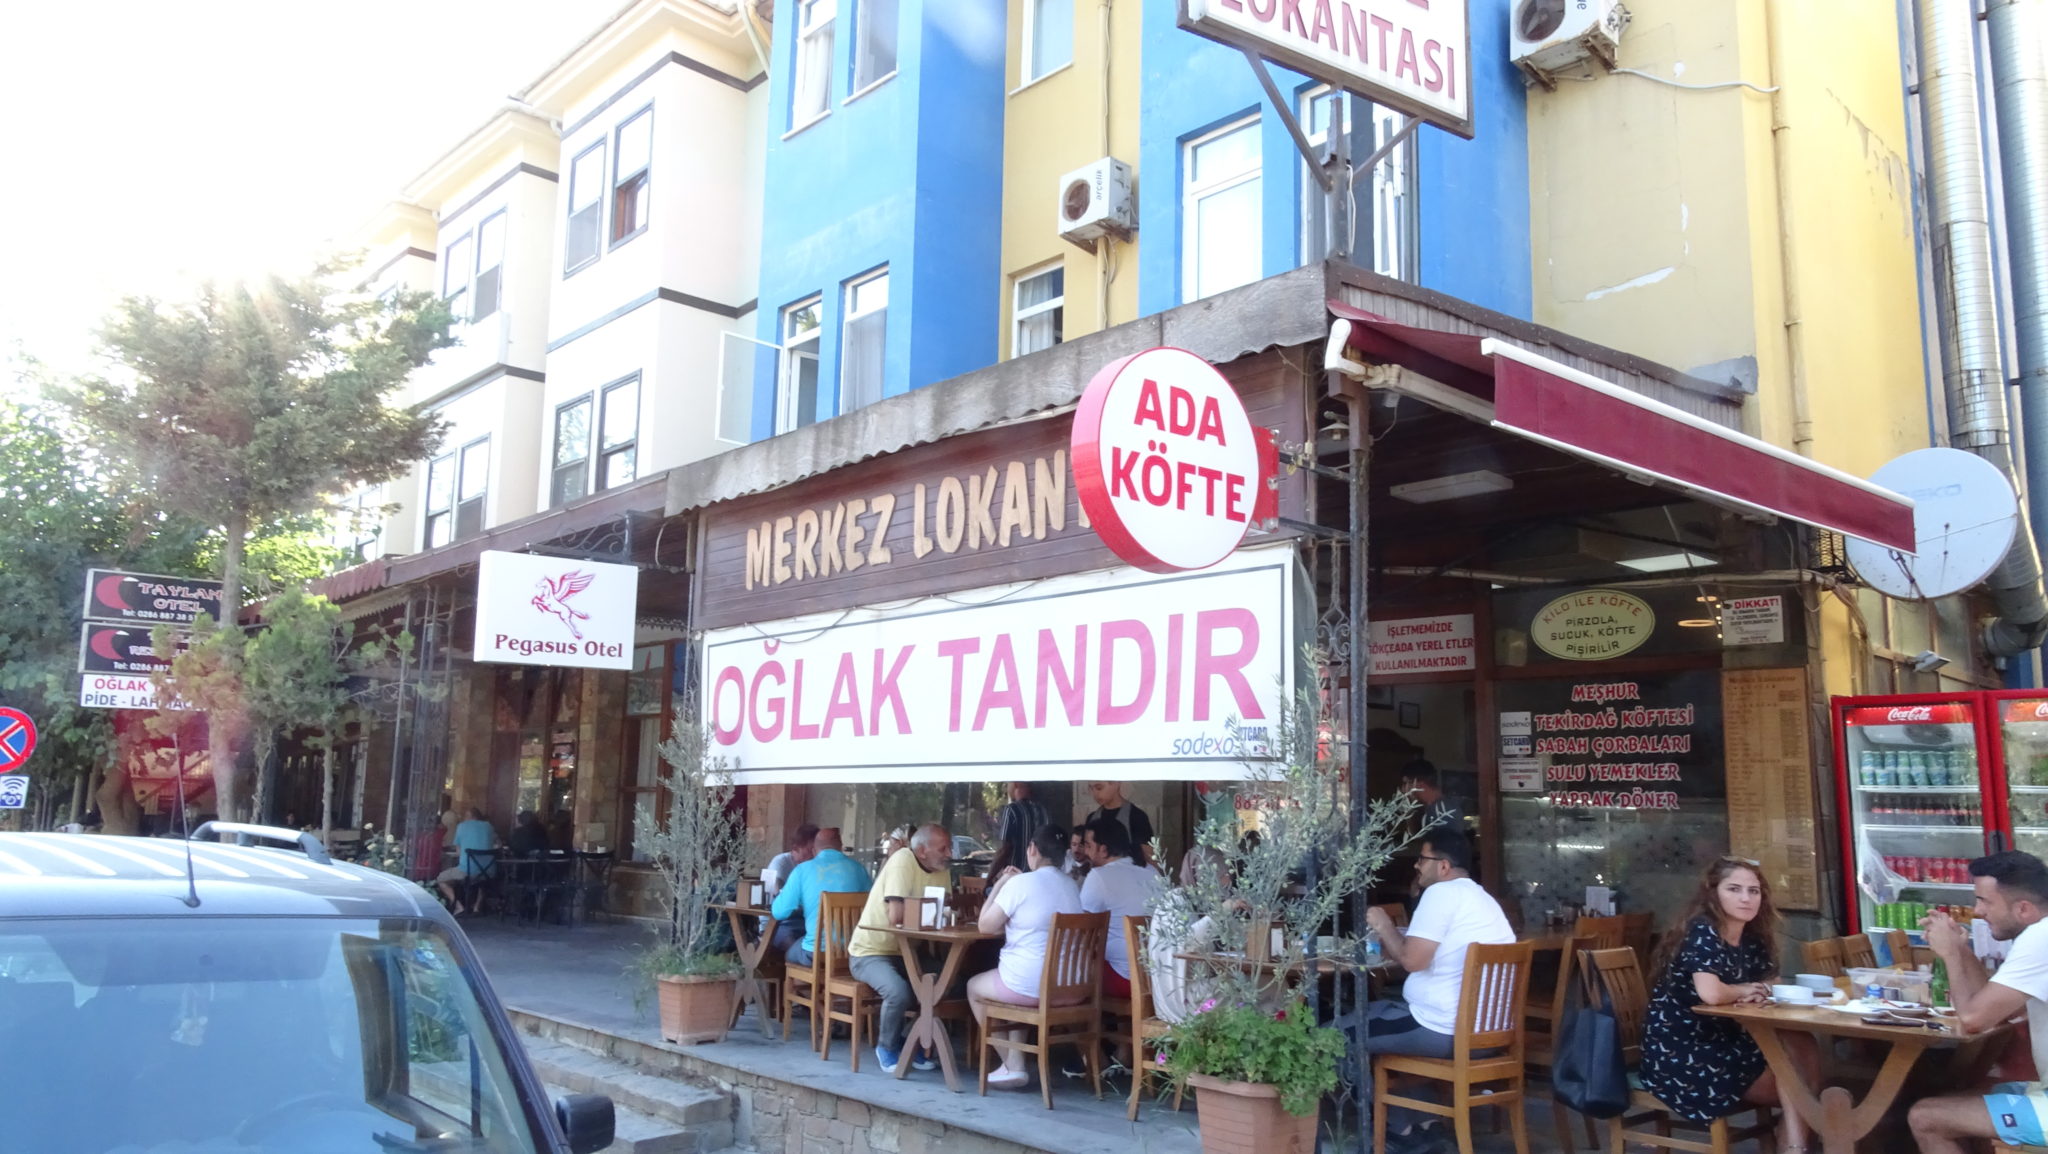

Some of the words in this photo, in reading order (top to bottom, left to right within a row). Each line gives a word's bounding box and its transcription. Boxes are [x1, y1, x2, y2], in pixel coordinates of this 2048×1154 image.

[1221, 0, 1455, 100] OKANTASI
[1134, 378, 1226, 447] ADA
[1111, 440, 1246, 523] KÖFTE
[746, 493, 896, 591] MERKEZ
[914, 449, 1091, 559] LOKAN
[153, 598, 205, 612] OTEL
[1600, 595, 1642, 616] KÖFTE
[1387, 621, 1453, 639] İŞLETMEMİZDE
[1598, 625, 1636, 637] KÖFTE
[495, 634, 577, 656] Pegasus
[584, 640, 623, 658] Otel
[1416, 640, 1443, 650] YEREL
[1446, 637, 1474, 649] ETLER
[1375, 655, 1467, 671] KULLANILMAKTADIR
[94, 677, 147, 691] OĞLAK
[712, 639, 915, 746] OĞLAK
[937, 607, 1265, 732] TANDIR
[85, 691, 117, 706] PİDE
[1571, 682, 1640, 705] MEŞHUR
[1534, 707, 1618, 732] TEKİRDAĞ
[1621, 703, 1694, 729] KÖFTESİ
[1171, 731, 1234, 755] sodexo
[1536, 737, 1589, 754] SABAH
[1591, 734, 1691, 758] ÇORBALARI
[1547, 764, 1586, 781] SULU
[1588, 763, 1681, 782] YEMEKLER
[1550, 791, 1615, 809] YAPRAK
[1618, 787, 1680, 810] DÖNER
